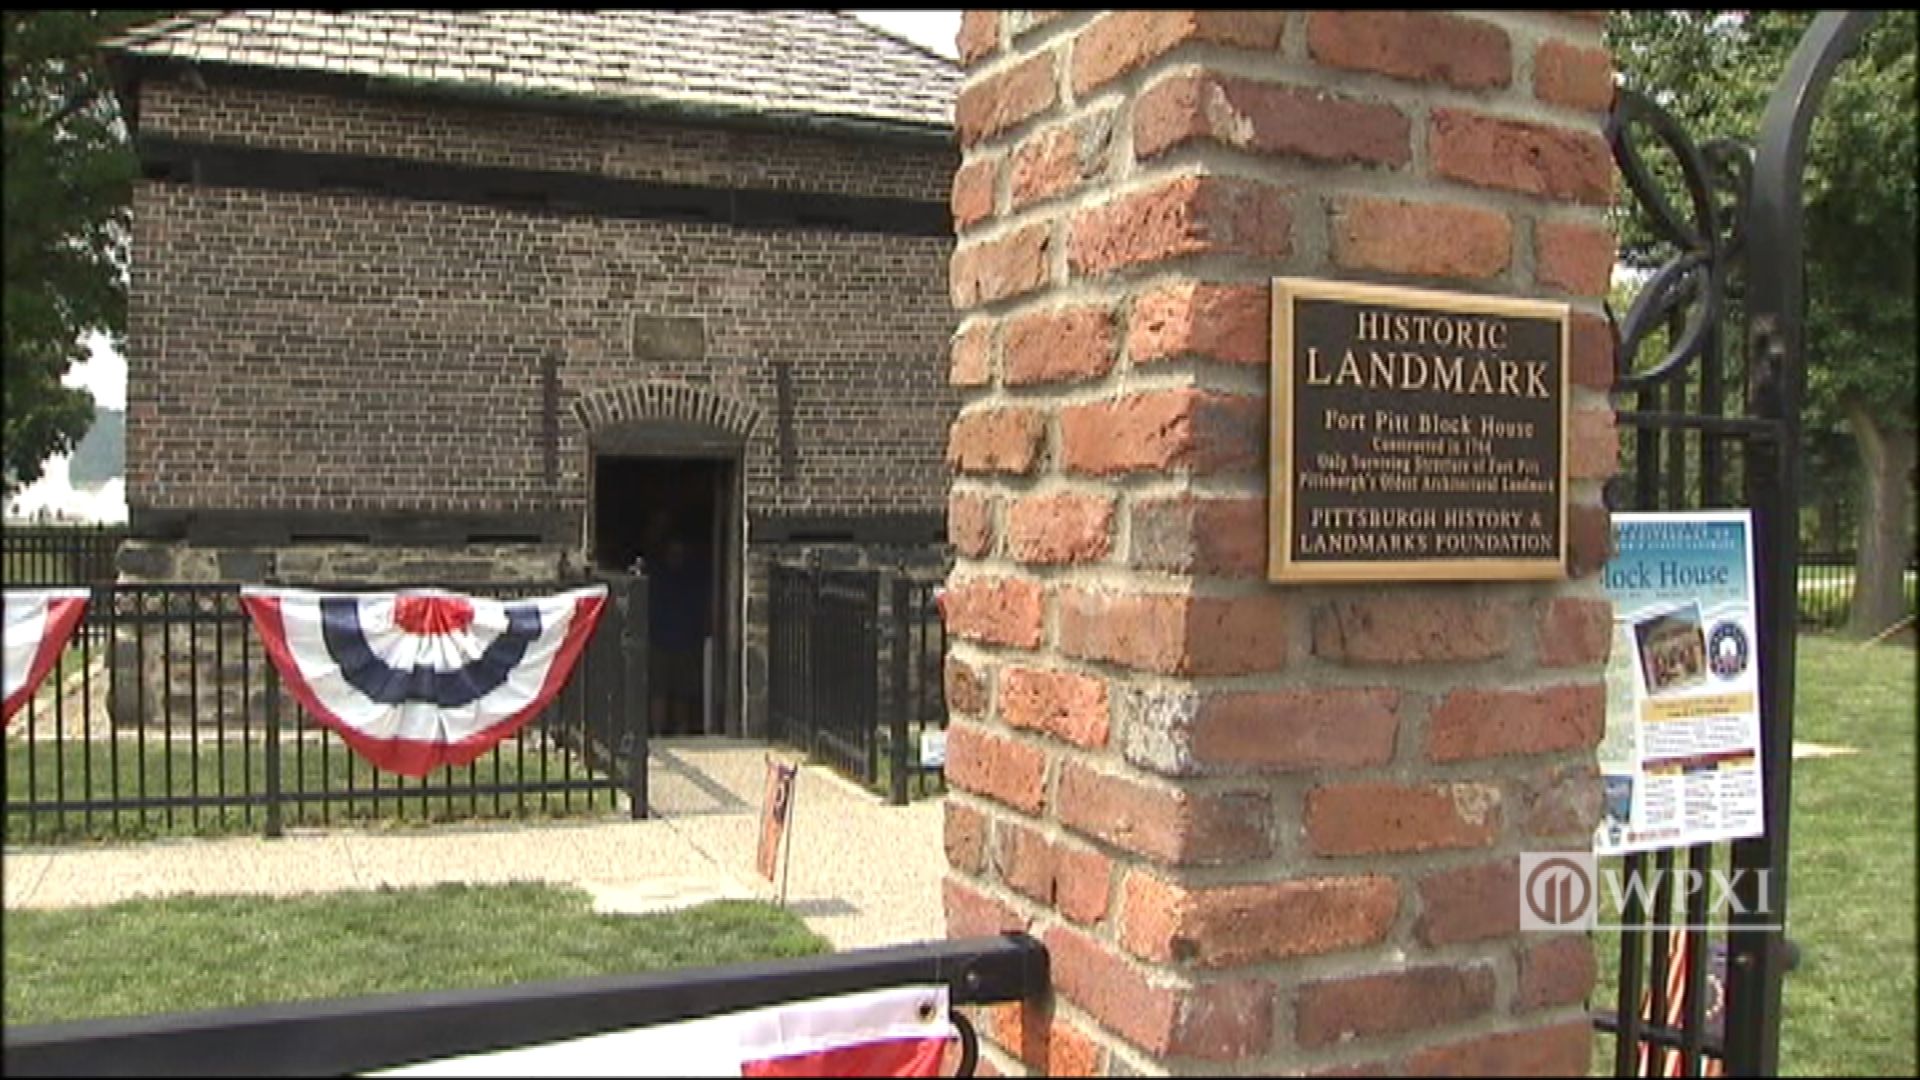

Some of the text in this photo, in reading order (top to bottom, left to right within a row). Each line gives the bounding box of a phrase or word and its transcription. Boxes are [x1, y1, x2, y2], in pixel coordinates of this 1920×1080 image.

[1358, 311, 1508, 350] HISTORIC
[1306, 347, 1550, 399] LANDMARK
[1324, 409, 1535, 439] Fort Pitt Block House
[1311, 507, 1543, 530] PITTSBURGH HISTORY &
[1301, 533, 1553, 553] LANDMARKS FOUNDATION
[1600, 560, 1730, 590] lock House
